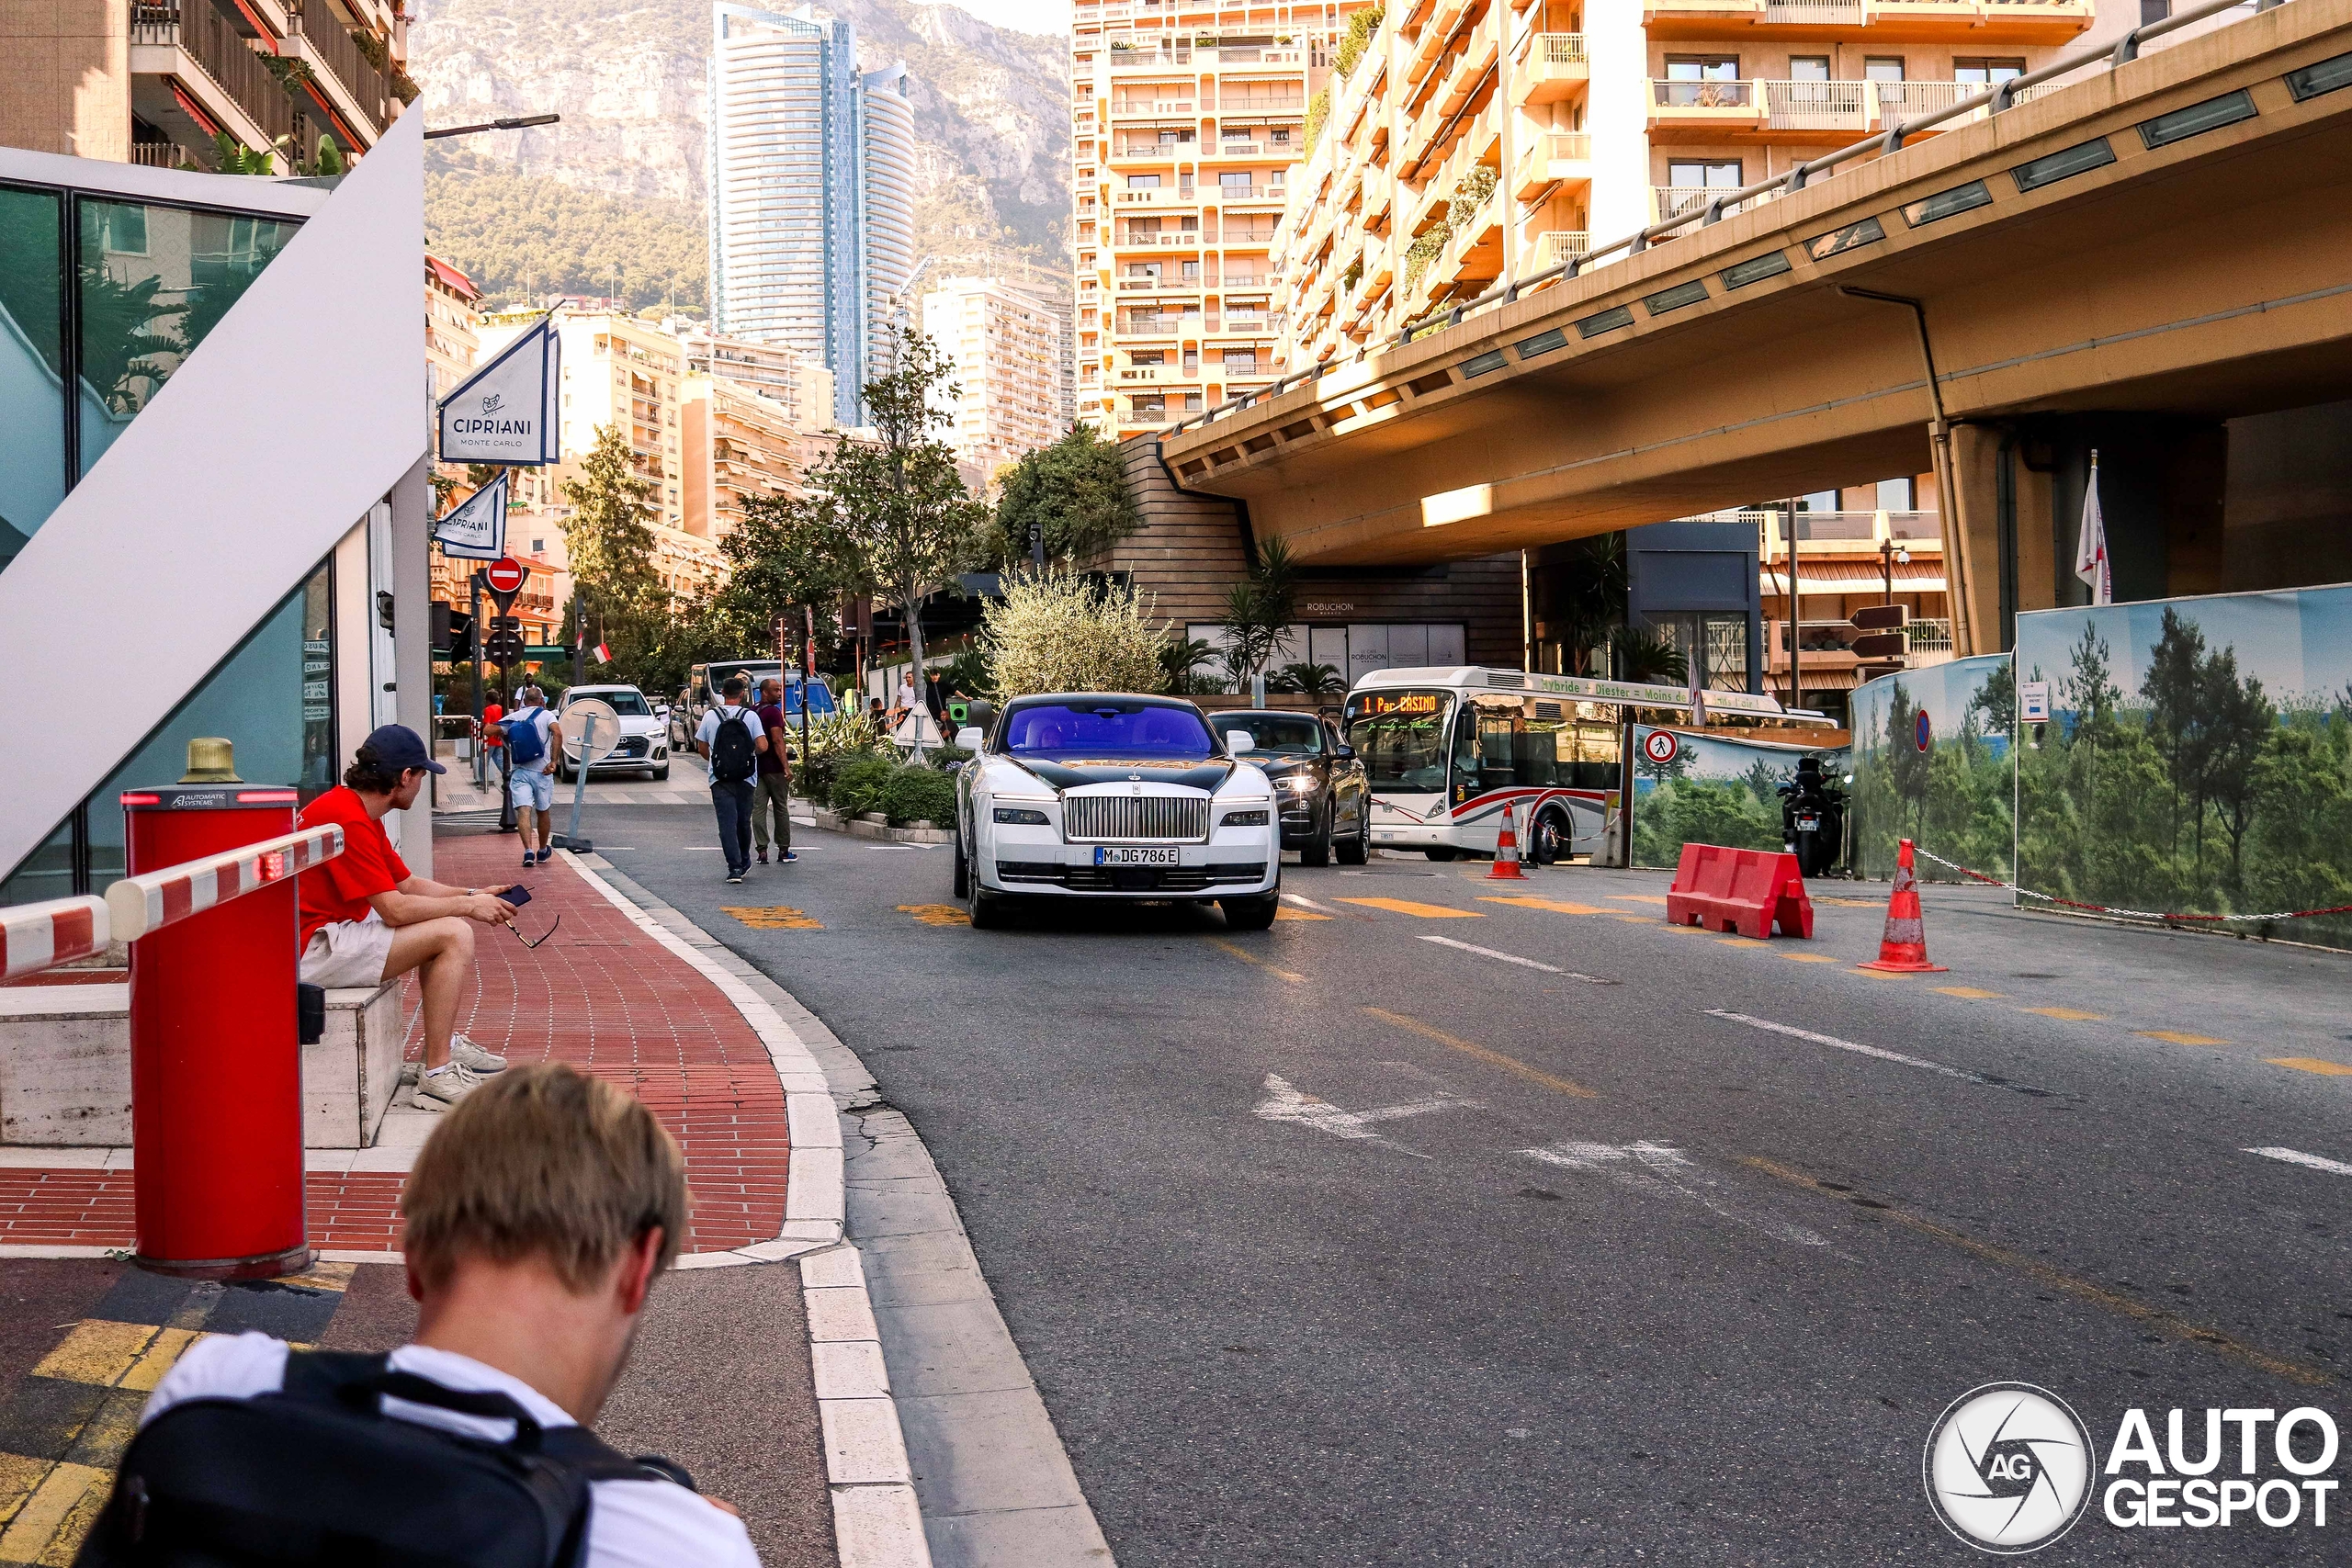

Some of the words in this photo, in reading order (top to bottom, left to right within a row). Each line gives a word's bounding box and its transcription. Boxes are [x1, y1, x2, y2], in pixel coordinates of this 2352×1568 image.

[454, 419, 531, 434] CIPRIANI
[447, 518, 488, 531] CIPRIANI
[1307, 603, 1354, 611] ROBUCHON
[1541, 678, 1580, 694] Hybride
[1595, 683, 1631, 697] Diester
[1645, 688, 1671, 701] Moins
[1676, 691, 1687, 703] de
[1364, 696, 1371, 713] 1
[1377, 696, 1395, 713] Par
[1400, 695, 1436, 712] CASINO
